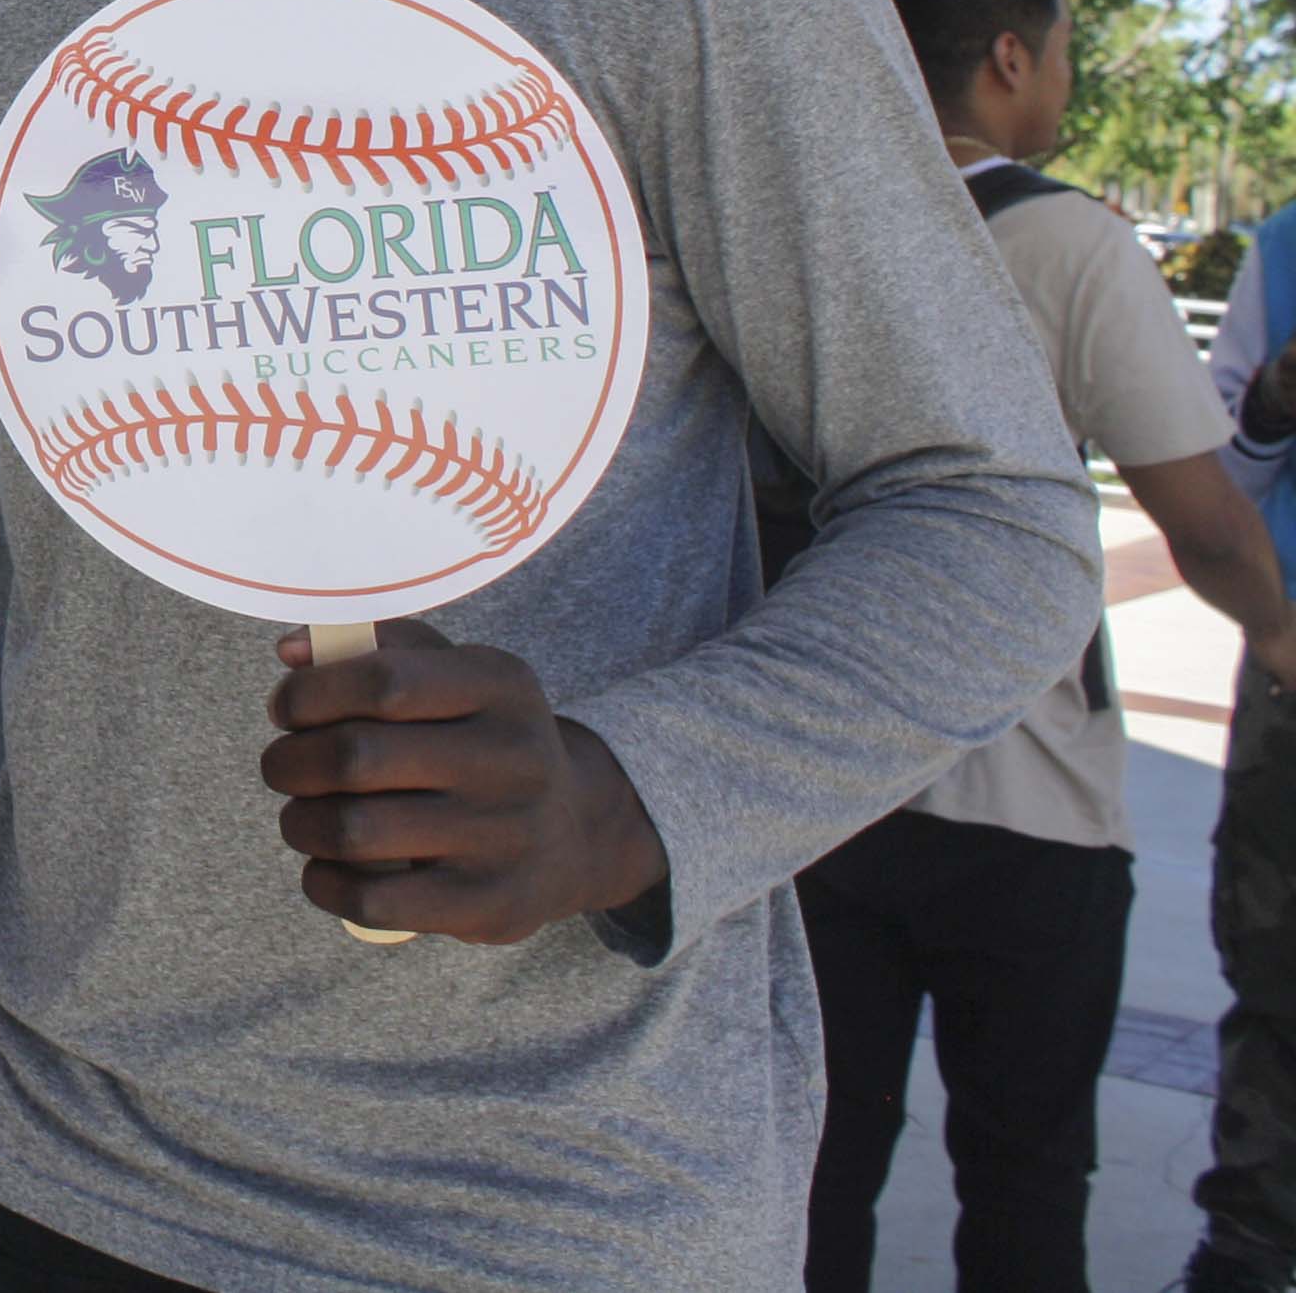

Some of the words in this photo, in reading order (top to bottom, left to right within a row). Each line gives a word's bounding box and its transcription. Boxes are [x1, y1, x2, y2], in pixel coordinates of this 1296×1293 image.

[113, 175, 146, 203] FSW
[190, 190, 587, 301] FLORIDA
[20, 276, 590, 363] SOUTHWESTERN
[253, 333, 598, 378] BUCCANEERS
